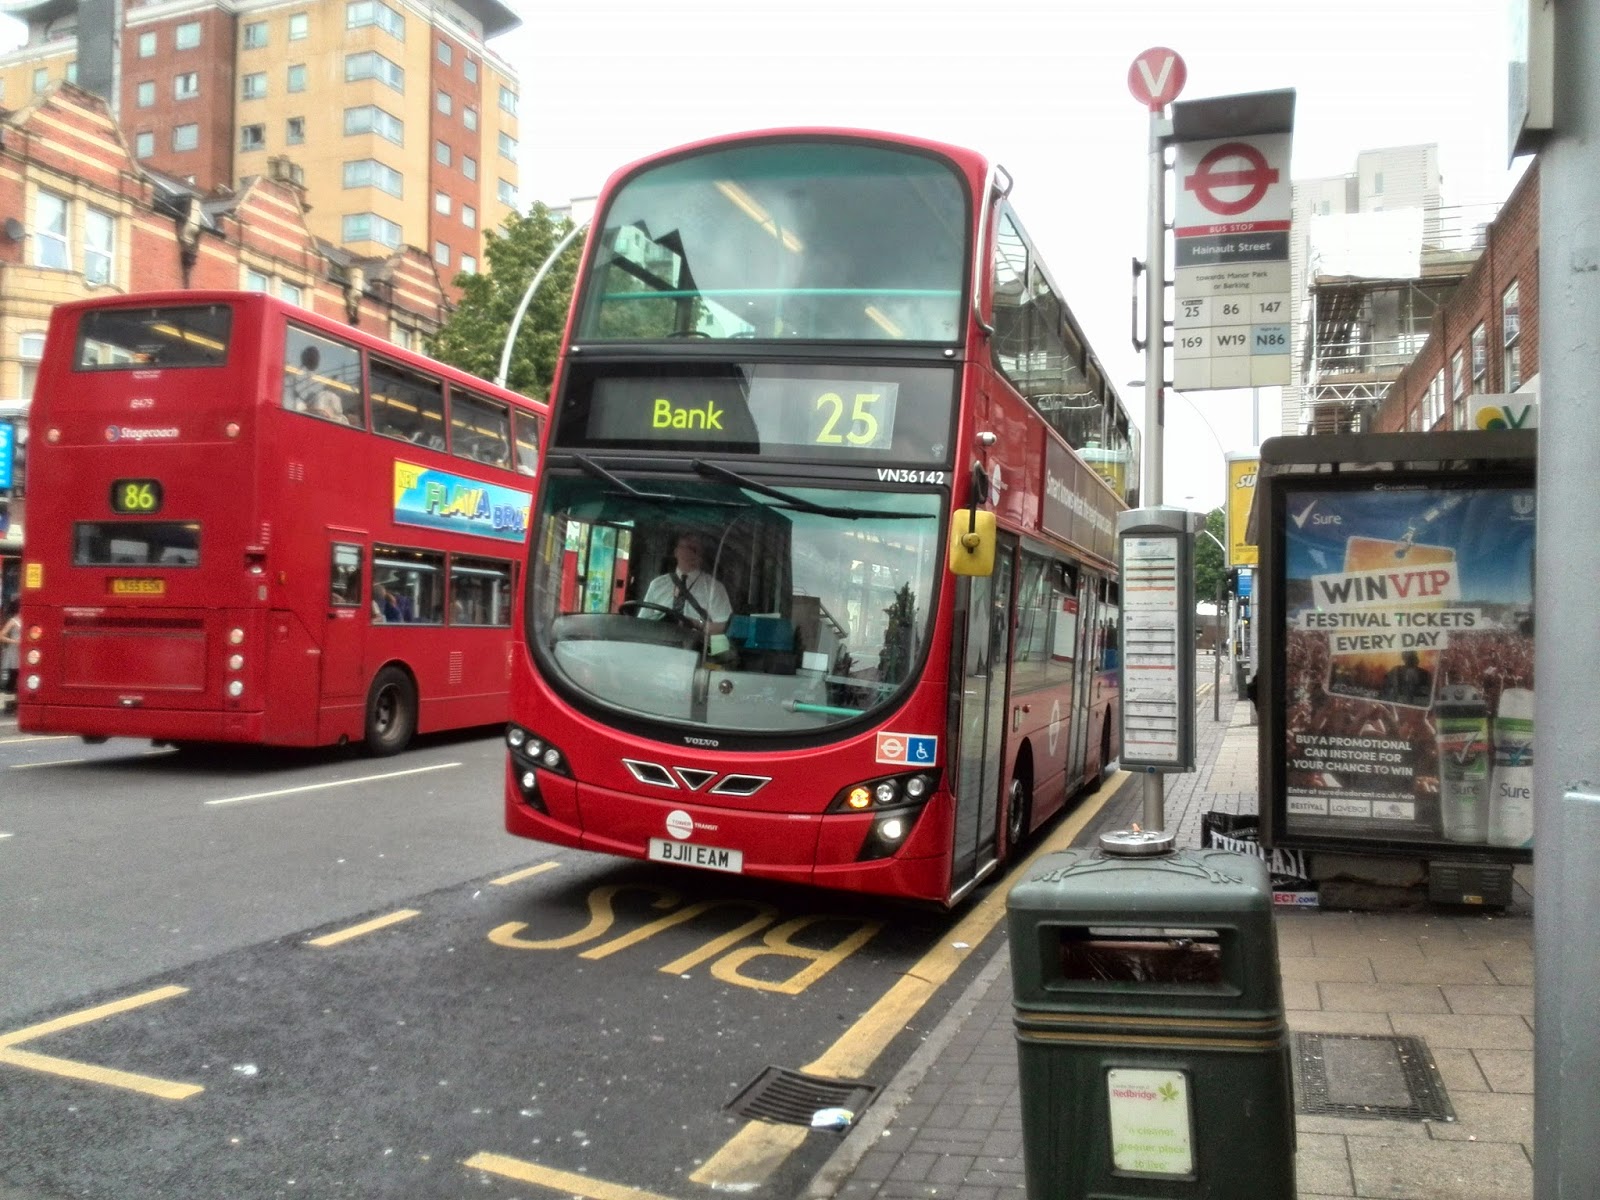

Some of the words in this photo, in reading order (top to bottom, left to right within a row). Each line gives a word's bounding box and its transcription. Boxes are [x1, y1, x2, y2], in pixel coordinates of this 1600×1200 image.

[1137, 57, 1174, 97] V
[1209, 225, 1227, 233] BUS
[1230, 223, 1254, 232] STOP
[1192, 243, 1235, 255] Hainault
[1238, 242, 1272, 252] Street
[1196, 272, 1225, 281] towards
[1228, 271, 1250, 279] Manor
[1223, 282, 1250, 290] Barking
[1185, 306, 1200, 318] 25
[1223, 303, 1240, 315] 86
[1260, 301, 1281, 313] 147
[1181, 336, 1203, 348] 169
[1217, 334, 1246, 346] W19
[1256, 334, 1286, 346] N86
[652, 398, 724, 430] Bank
[816, 392, 881, 445] 25
[121, 427, 179, 440] Stagecoach
[877, 468, 945, 485] VN36142
[124, 483, 154, 509] 86
[425, 481, 491, 519] FLAVA
[1312, 509, 1342, 525] Sure
[1320, 574, 1388, 605] WIN
[1389, 569, 1450, 599] VIP
[1306, 612, 1390, 628] FESTIVAL
[1394, 611, 1476, 627] TICKETS
[1336, 632, 1397, 651] EVERY
[1402, 631, 1441, 648] DAY
[684, 736, 719, 747] VOLVO
[1296, 734, 1319, 744] BUY
[1320, 736, 1328, 745] A
[1329, 737, 1412, 751] PROMOTIONAL
[1304, 748, 1328, 758] CAN
[1330, 749, 1377, 762] INSTORE
[1379, 753, 1402, 763] FOR
[1293, 759, 1324, 770] YOUR
[1325, 762, 1372, 773] CHANCE
[1374, 765, 1389, 774] TO
[1391, 767, 1413, 776] WIN
[1500, 782, 1531, 799] Sure
[1332, 805, 1369, 813] LOVEBOX
[671, 819, 692, 827] TOWER
[694, 822, 718, 831] TRANSIT
[696, 848, 729, 868] EAM
[487, 884, 882, 994] BUS
[1113, 1088, 1157, 1101] Redbridge
